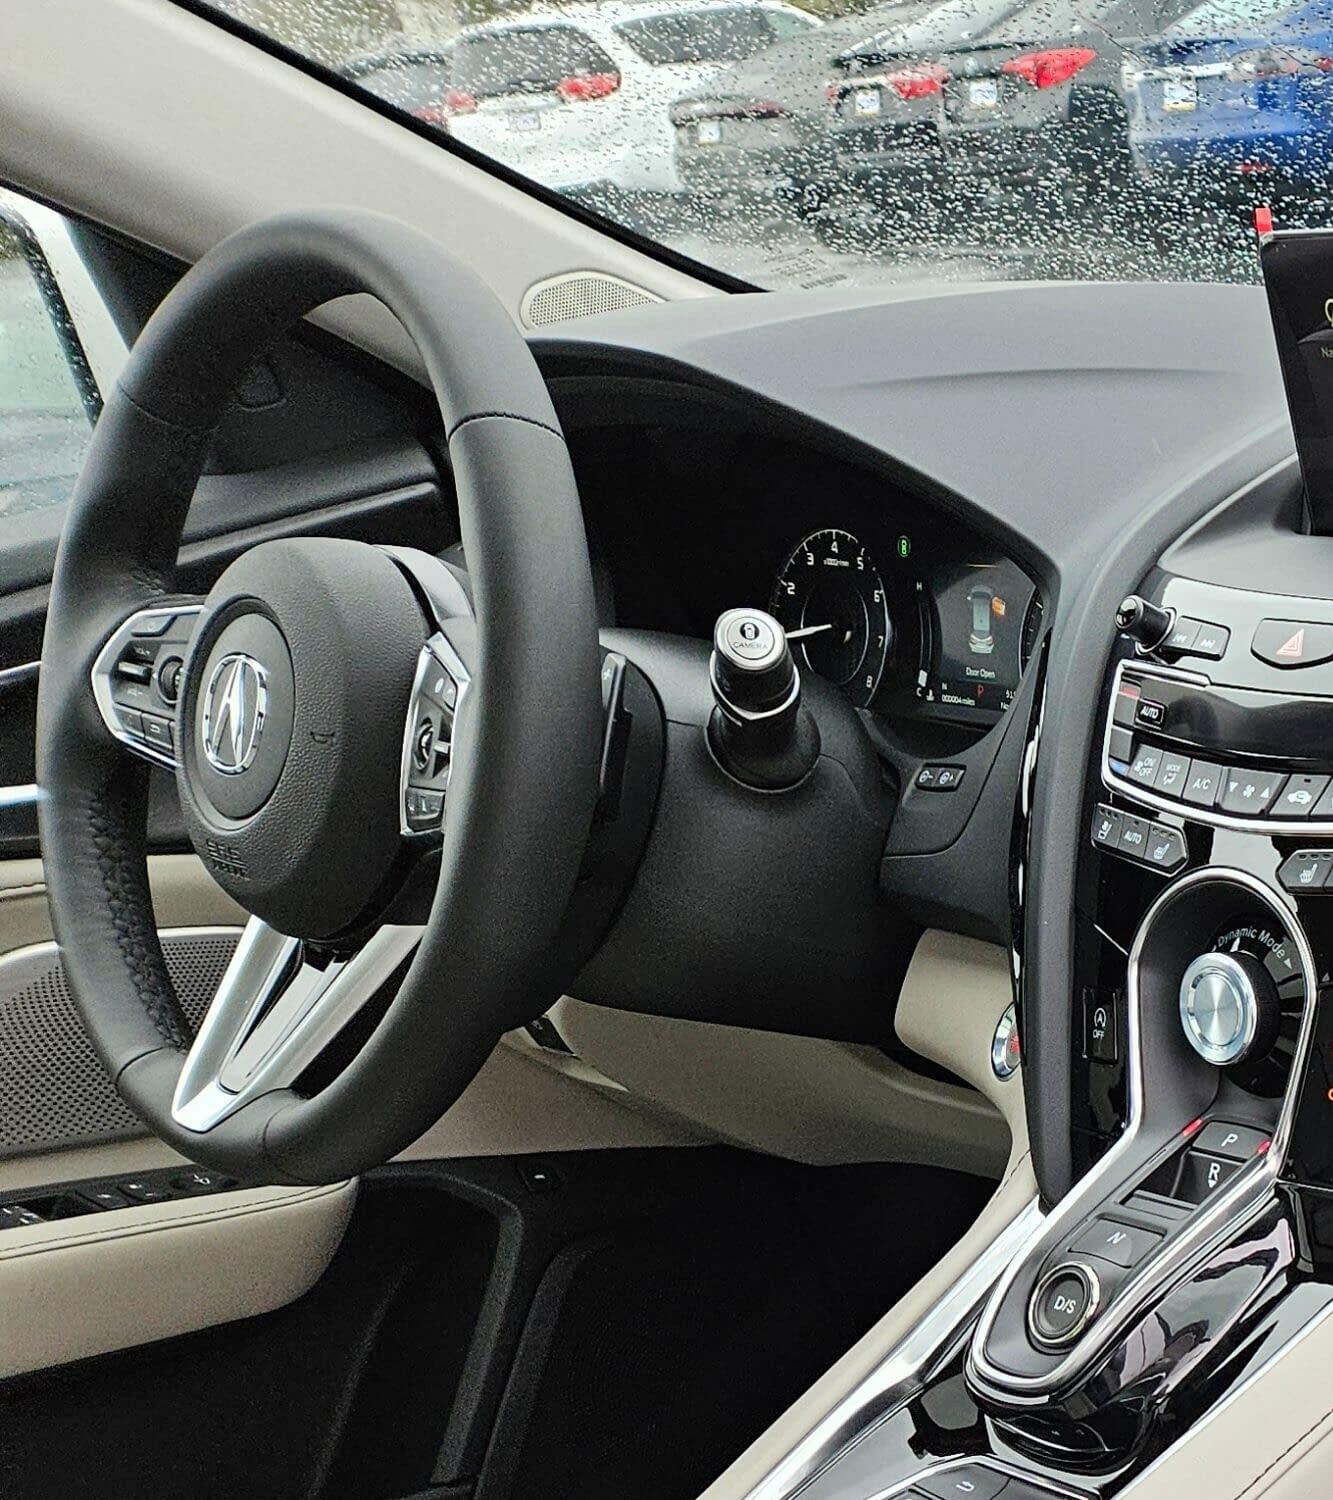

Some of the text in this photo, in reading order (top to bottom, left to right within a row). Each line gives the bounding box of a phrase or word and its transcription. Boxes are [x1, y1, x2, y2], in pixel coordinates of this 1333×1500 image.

[831, 541, 839, 553] 4
[806, 552, 815, 566] 3
[787, 582, 796, 595] 2
[1140, 706, 1159, 718] AUTO
[1192, 778, 1211, 790] A/C
[1124, 830, 1143, 844] AUTO
[1217, 926, 1286, 959] Dynamic Mode
[1092, 1029, 1104, 1040] OFF
[1221, 1132, 1239, 1147] P
[1208, 1162, 1220, 1181] R
[1107, 1231, 1126, 1245] N
[1054, 1295, 1077, 1314] D/S
